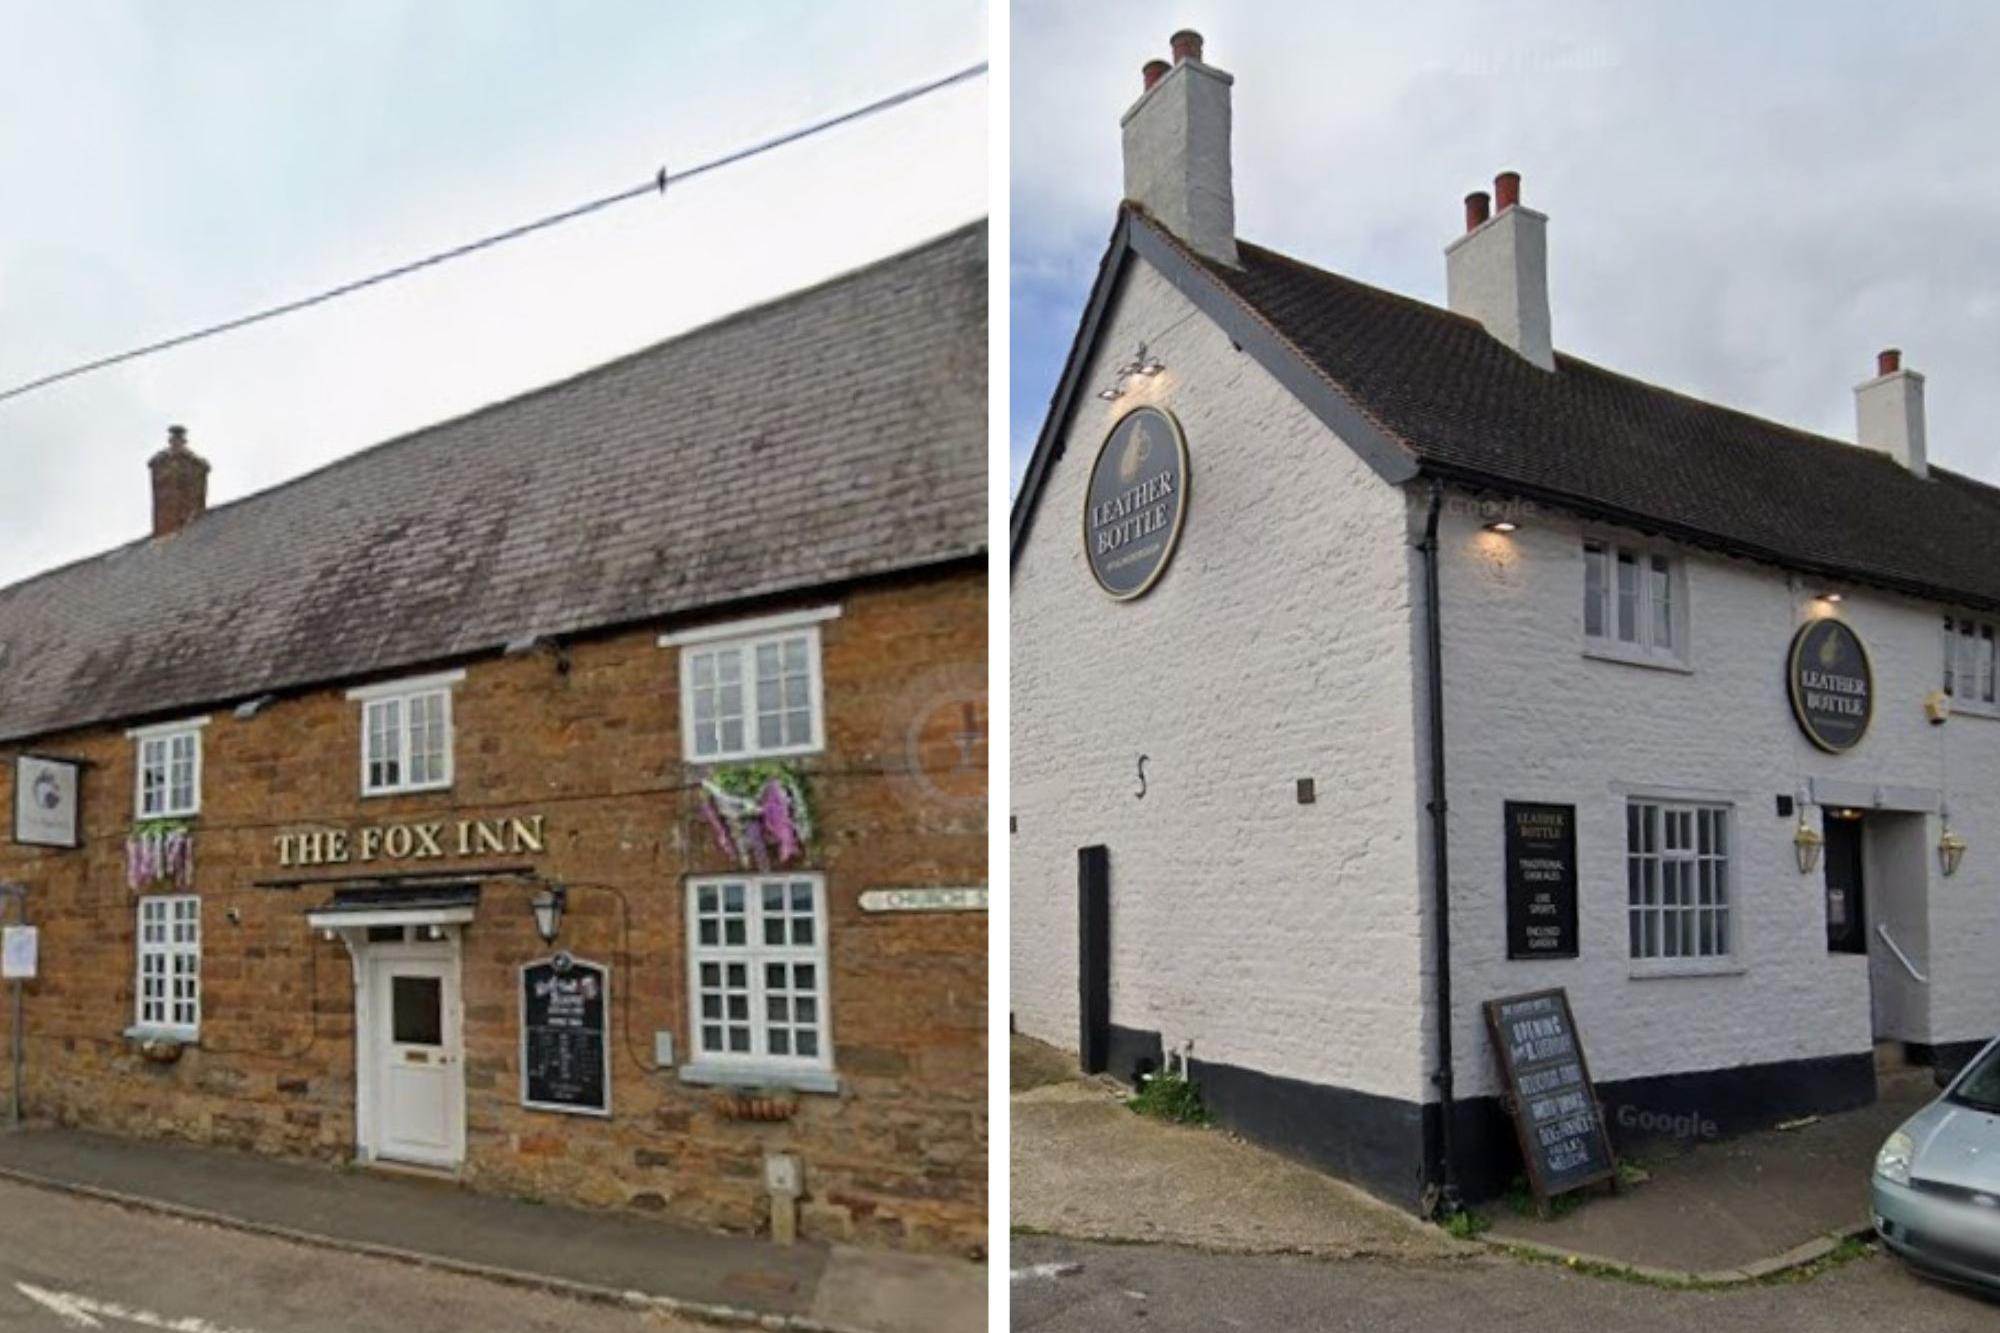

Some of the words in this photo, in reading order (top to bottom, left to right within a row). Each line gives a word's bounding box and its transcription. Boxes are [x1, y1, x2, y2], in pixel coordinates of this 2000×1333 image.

[1093, 470, 1173, 528] LEATHER
[1098, 503, 1168, 554] BOTTLE
[1802, 671, 1866, 696] LEATHER
[1806, 691, 1863, 716] BOTTLE
[274, 830, 349, 866] THE
[359, 823, 443, 861] FOX
[456, 815, 544, 857] INN
